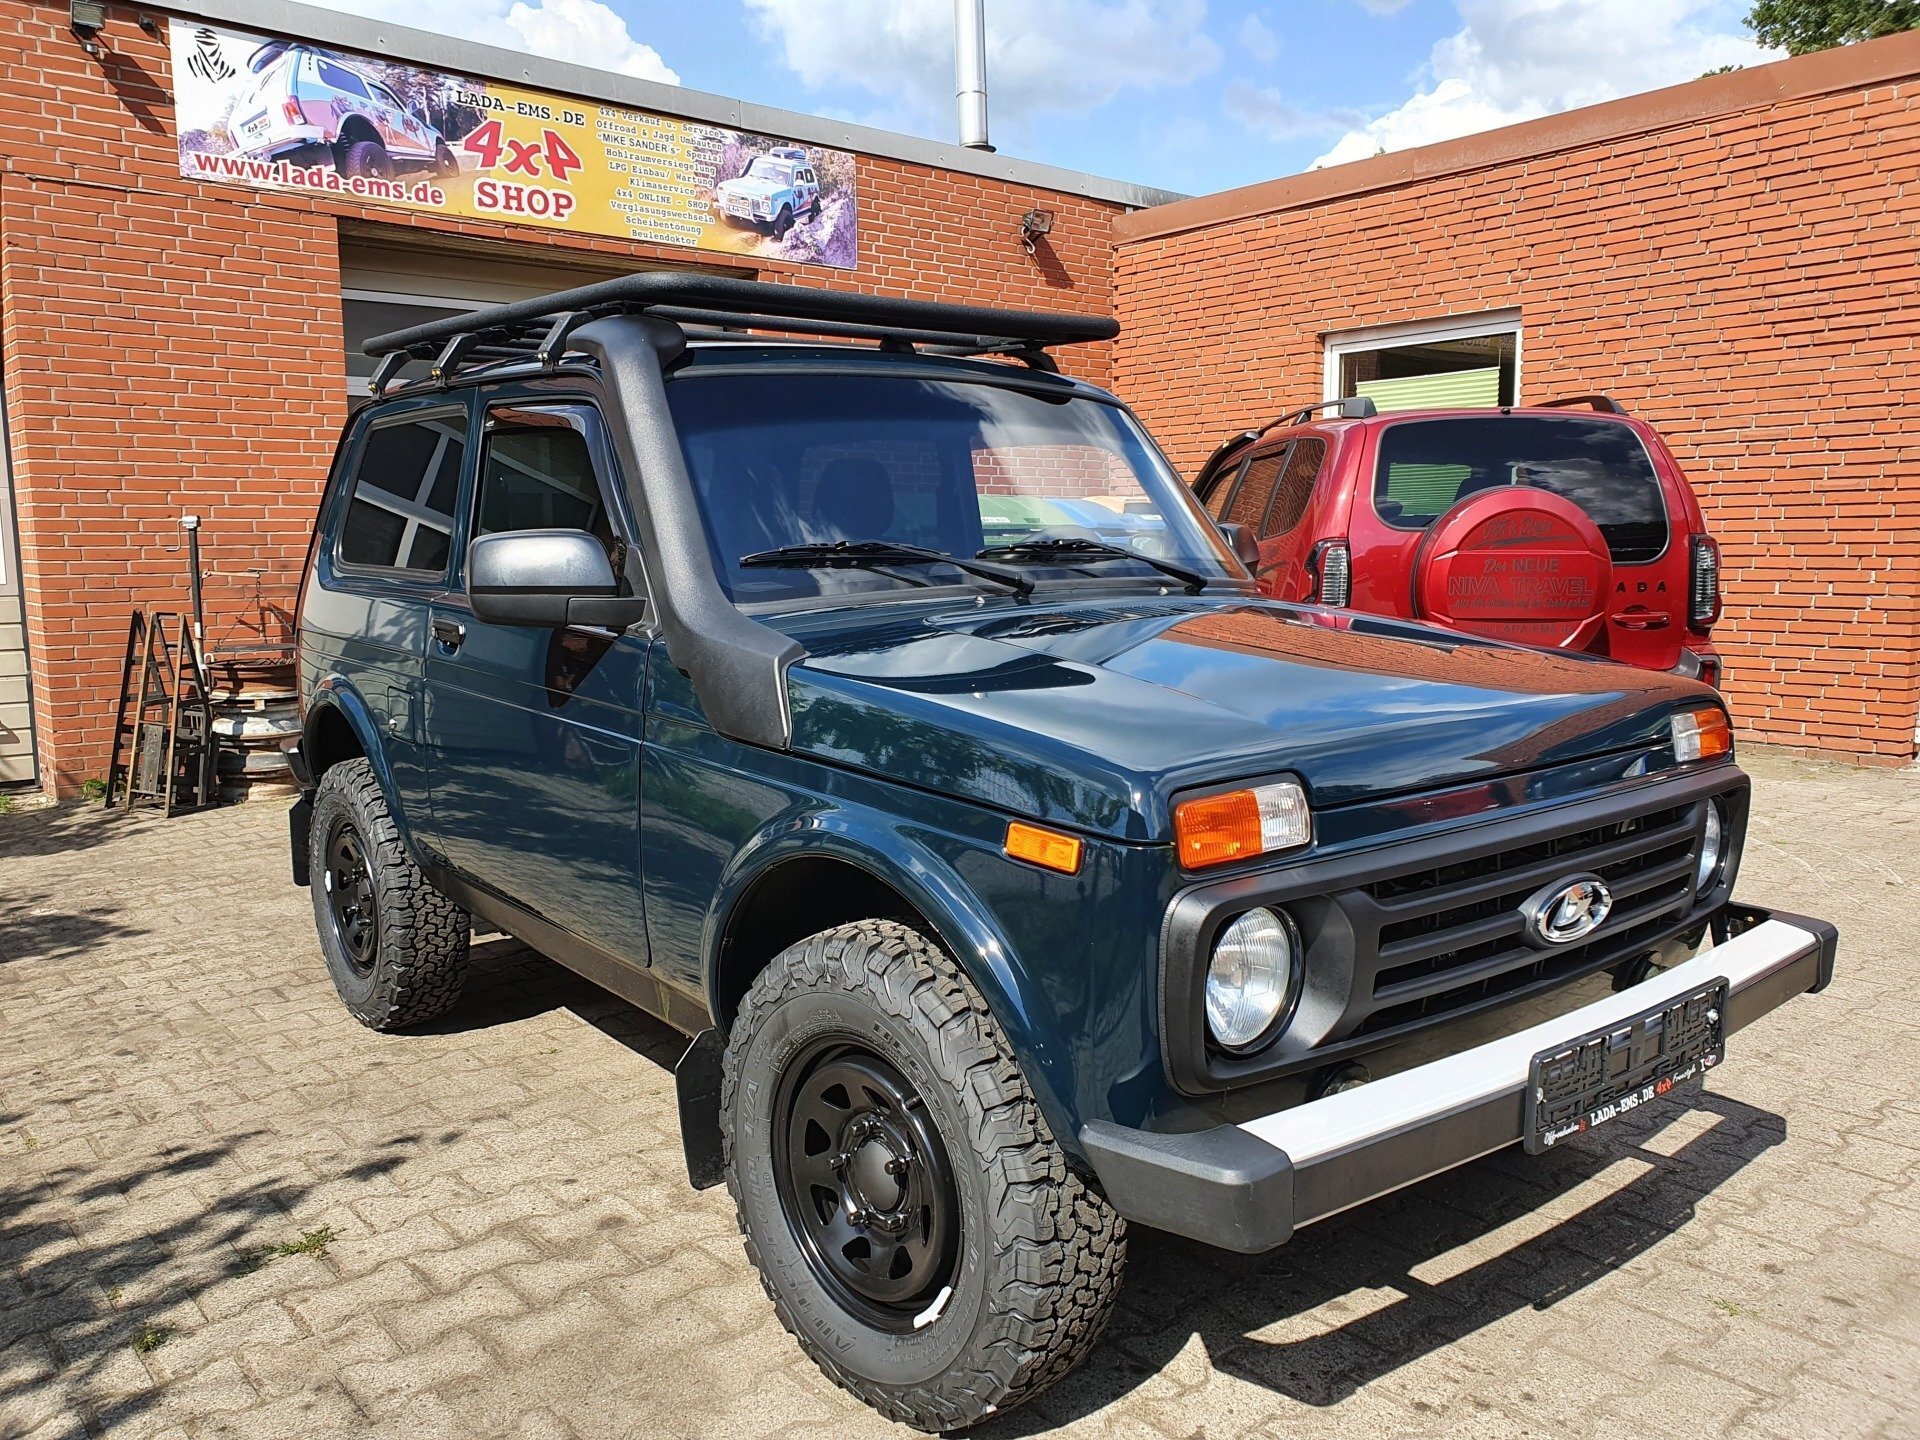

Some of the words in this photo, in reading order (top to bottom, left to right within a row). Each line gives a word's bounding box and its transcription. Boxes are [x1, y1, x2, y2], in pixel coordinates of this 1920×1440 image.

[456, 90, 585, 126] LADA-EMS.DE
[596, 120, 637, 134] Offroad
[642, 128, 647, 136] &
[653, 130, 675, 143] Jagd
[680, 135, 722, 150] Umbauten
[600, 107, 616, 118] 4x4
[621, 110, 661, 125] Verkauf
[666, 121, 676, 129] u.
[682, 123, 720, 137] Service
[463, 120, 582, 181] 4x4
[606, 148, 716, 175] Hohlraumversiegelung
[686, 149, 723, 163] Spezial
[193, 153, 444, 205] www.lada-ems.de
[609, 161, 627, 171] LPG
[632, 165, 670, 178] Einbau/
[676, 172, 713, 187] Wartung
[629, 178, 695, 195] Klimaservice
[477, 181, 573, 218] SHOP
[610, 200, 715, 223] Verglasungswechseln
[616, 188, 633, 198] 4x4
[638, 192, 672, 204] ONLINE
[687, 200, 709, 210] SHOP
[625, 215, 702, 235] Scheibentönung
[632, 229, 696, 245] Beulendoktor
[1484, 558, 1507, 574] Der
[1512, 558, 1560, 573] NEUE
[1448, 576, 1502, 596] NIVA
[1510, 576, 1595, 596] TRAVEL
[1616, 581, 1667, 594] ADA
[1590, 1085, 1655, 1127] LADA-EMS.DE
[1656, 1077, 1673, 1095] 4x4
[873, 1018, 979, 1277] BFGoodrich
